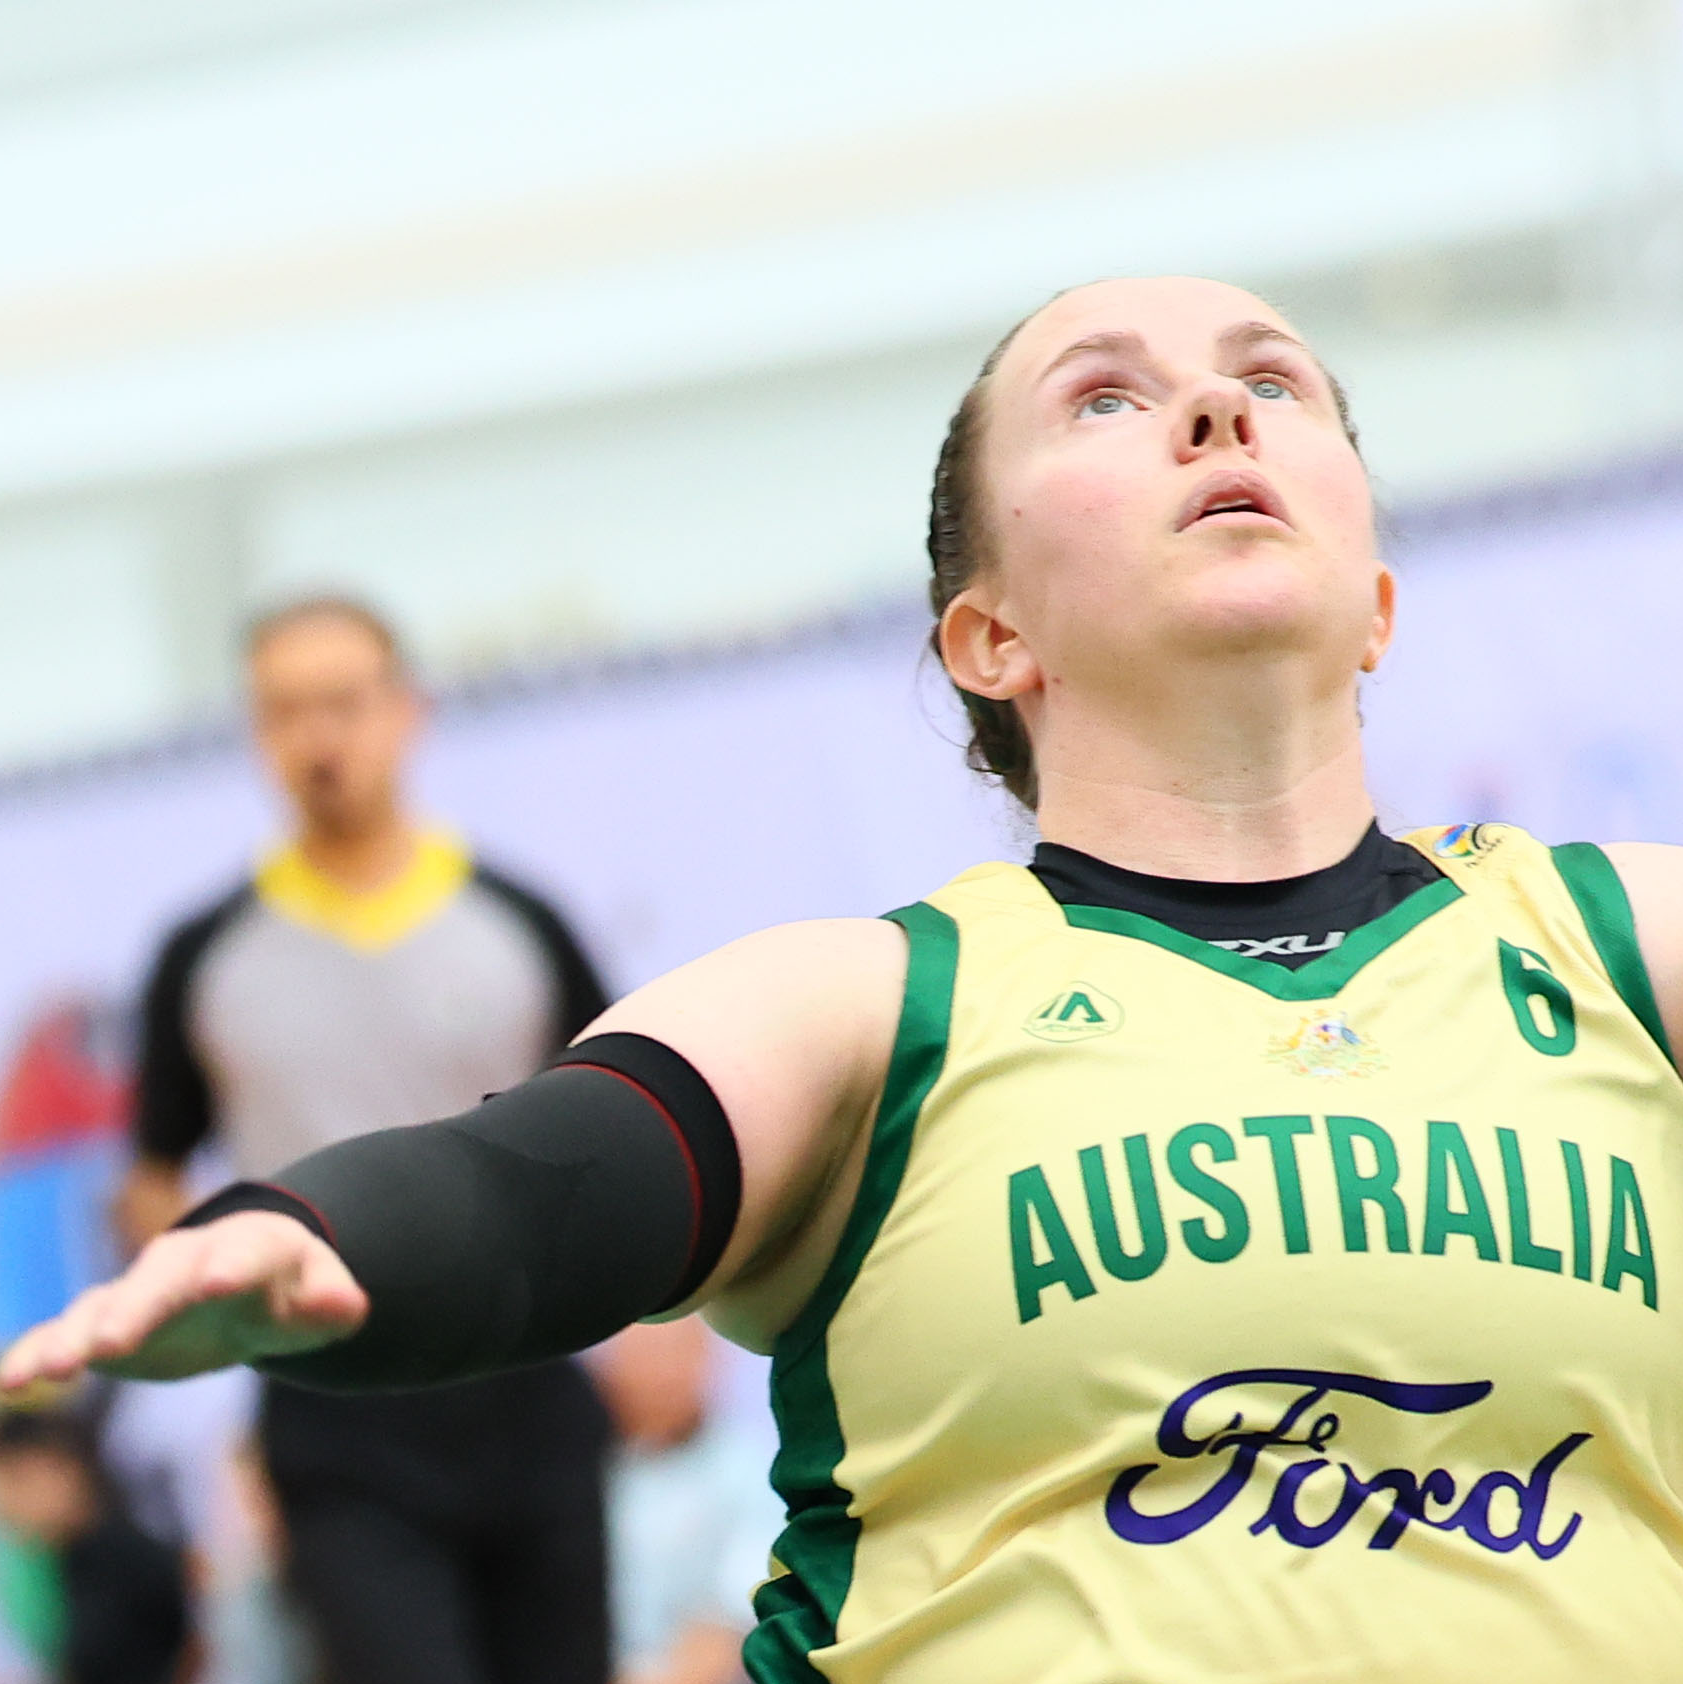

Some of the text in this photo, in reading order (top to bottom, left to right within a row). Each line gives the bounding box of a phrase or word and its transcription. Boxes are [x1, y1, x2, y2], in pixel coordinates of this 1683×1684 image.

[1497, 936, 1576, 1057] 6
[1008, 1115, 1660, 1325] AUSTRALIA
[1104, 1367, 1593, 1561] Ford
